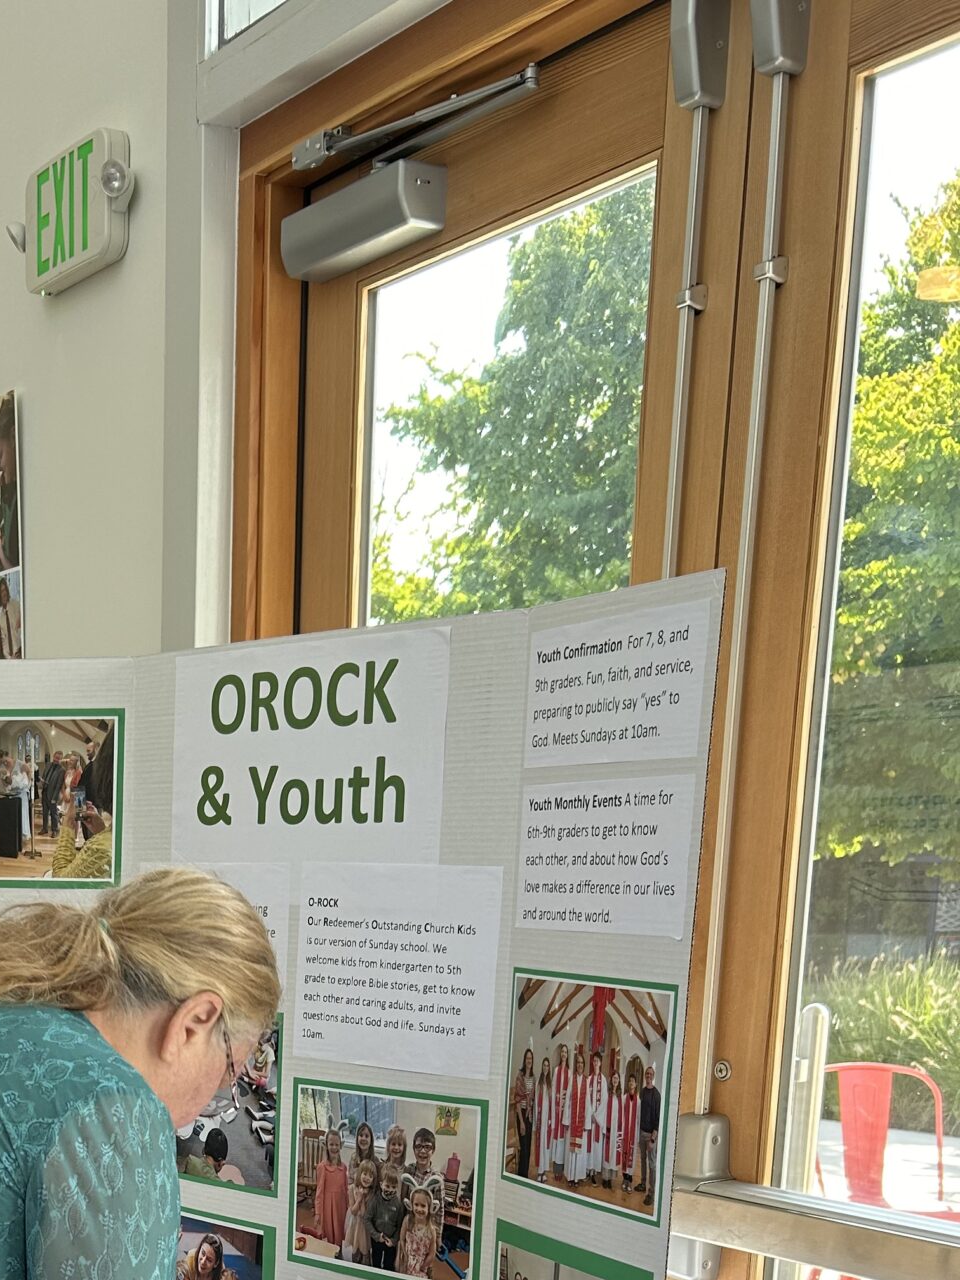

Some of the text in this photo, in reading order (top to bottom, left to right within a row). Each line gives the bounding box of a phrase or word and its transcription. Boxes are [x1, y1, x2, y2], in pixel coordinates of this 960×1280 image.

[37, 138, 94, 277] EXIT
[537, 625, 689, 665] Youth Confirmation For 7, 8, and
[535, 657, 694, 693] 9th graders. Fun, faith, and service,
[211, 658, 399, 735] OROCK
[533, 704, 572, 724] preparing
[574, 702, 584, 716] to
[585, 695, 620, 715] publicly
[622, 697, 637, 712] say
[669, 691, 680, 704] to
[532, 724, 660, 749] God. Meets Sundays at 10am.
[197, 756, 406, 826] & Youth
[529, 790, 674, 814] Youth Monthly Events A time for
[527, 822, 658, 842] 6th-9th graders to get to know
[525, 852, 543, 867] each
[545, 852, 570, 868] other,
[571, 852, 588, 866] and
[589, 852, 615, 866] about
[618, 852, 638, 866] how
[524, 881, 675, 897] love makes a difference in our lives
[308, 897, 339, 908] O-ROCK
[307, 916, 322, 926] Our
[371, 920, 422, 934] Outstanding
[424, 923, 455, 934] Church
[457, 925, 477, 936] Kids
[523, 908, 612, 924] and around the world.
[306, 936, 447, 954] is our version of Sunday school. We
[306, 955, 462, 975] welcome kids from kindergarten to 5th
[304, 973, 475, 997] grade to explore Bible stories, get to know
[303, 992, 461, 1016] each other and caring adults, and invite
[302, 1028, 325, 1040] 10am.
[303, 1011, 466, 1037] questions about God and life. Sundays at
